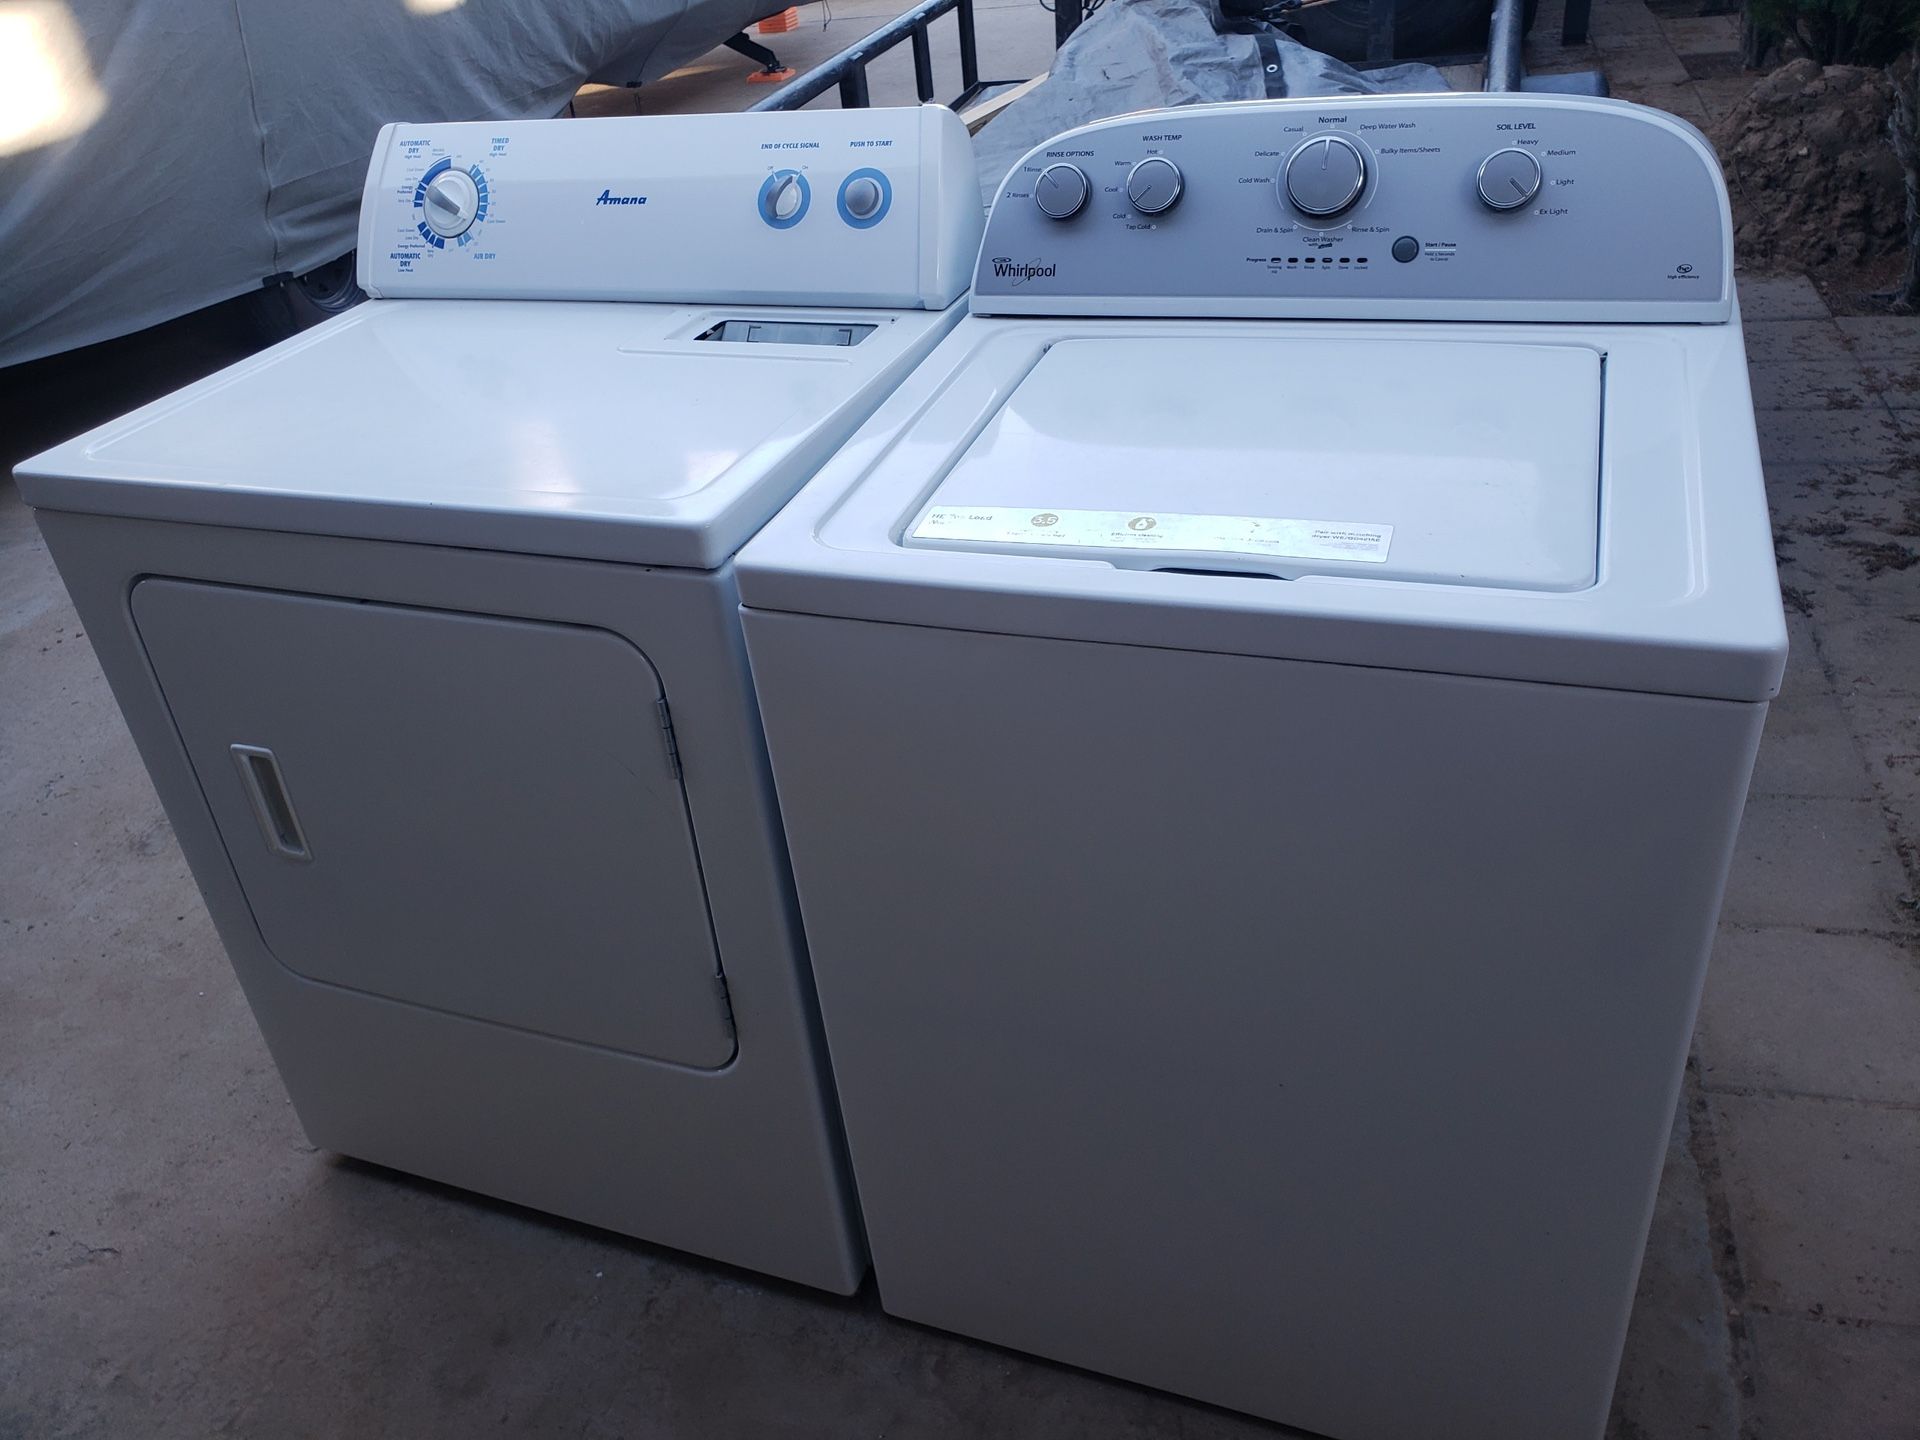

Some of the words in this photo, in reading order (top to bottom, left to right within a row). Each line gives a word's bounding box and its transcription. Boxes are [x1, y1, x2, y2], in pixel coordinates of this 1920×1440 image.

[1318, 116, 1347, 124] Normal
[1514, 122, 1536, 130] LEVEL
[1556, 178, 1574, 186] Light
[596, 189, 647, 206] Amana
[1549, 208, 1568, 216] Light
[1278, 226, 1293, 235] Spin
[1374, 226, 1390, 234] Spin
[994, 263, 1056, 281] Whirlpool
